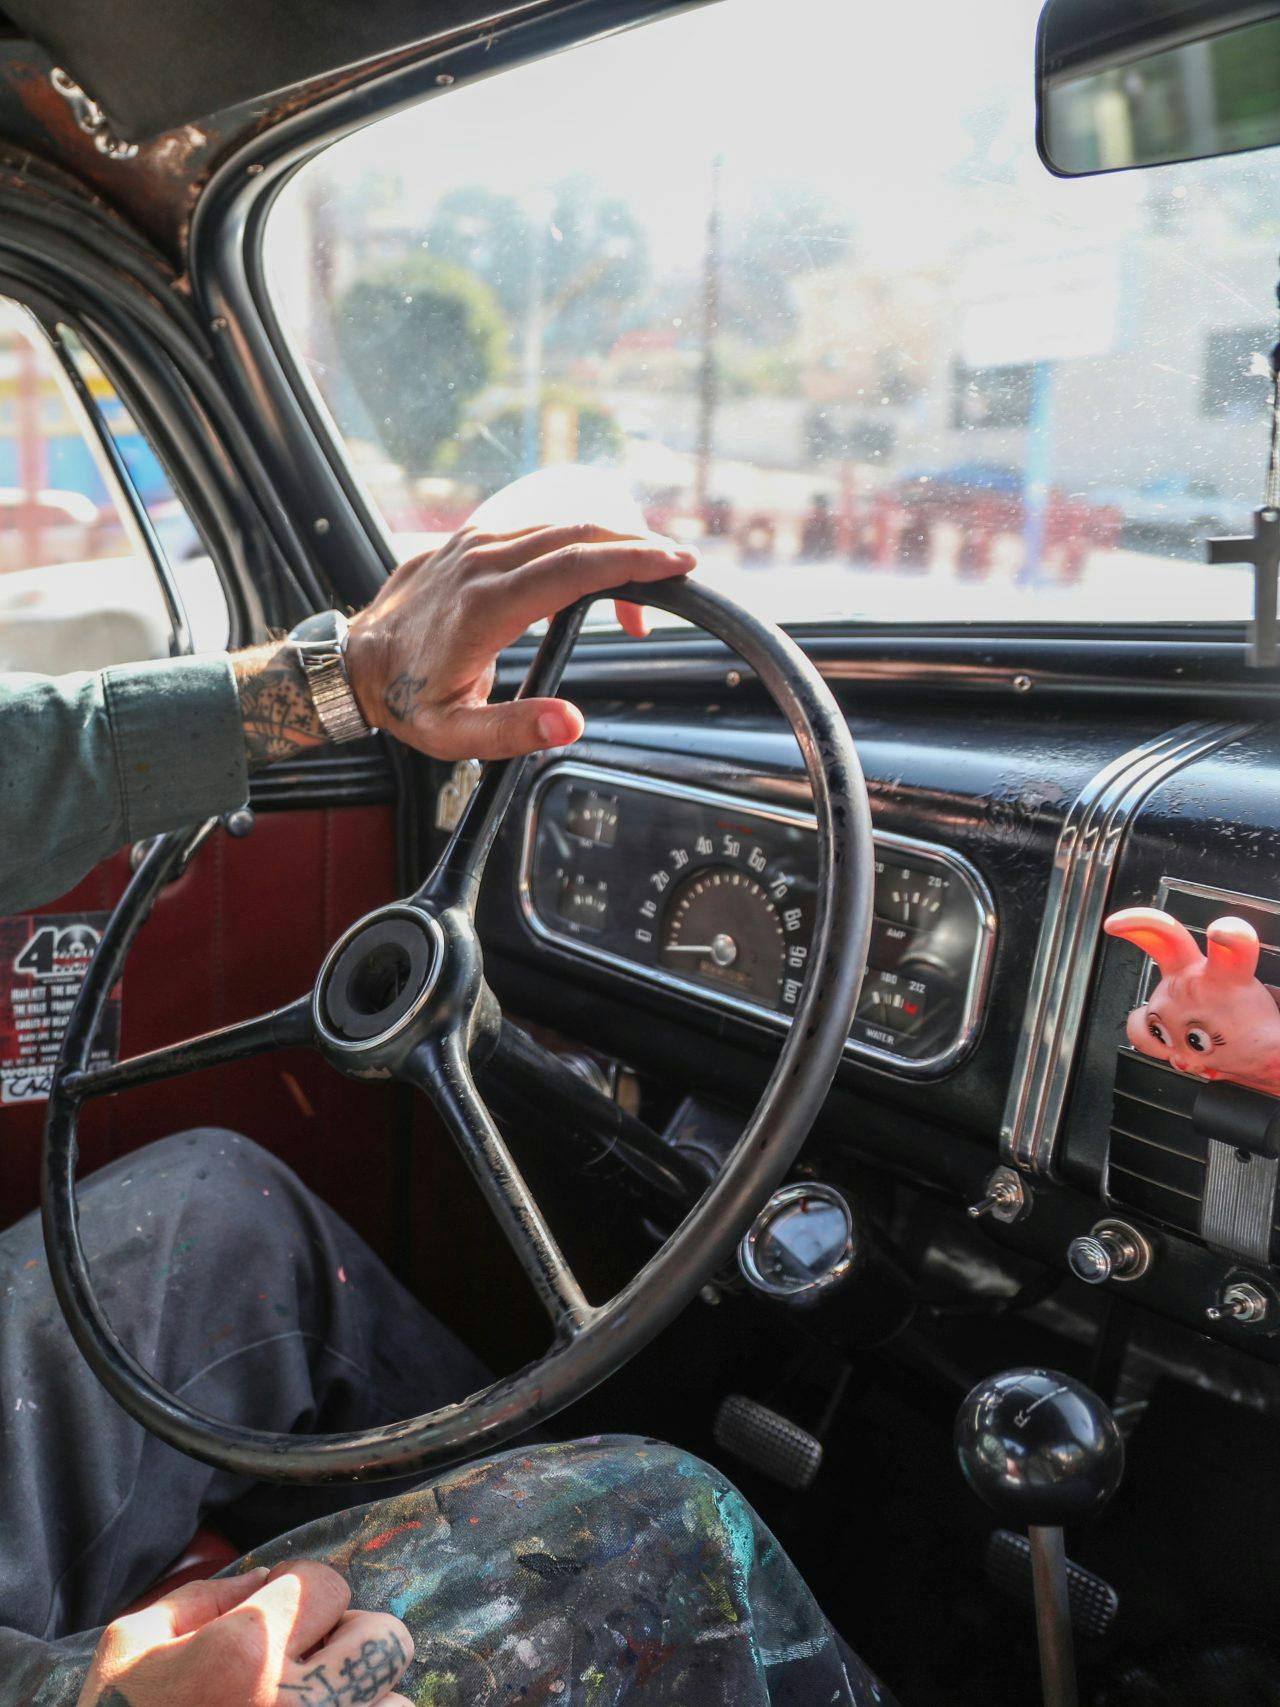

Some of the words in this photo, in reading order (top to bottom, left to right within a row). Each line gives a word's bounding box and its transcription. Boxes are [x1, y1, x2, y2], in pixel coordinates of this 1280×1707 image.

[695, 836, 713, 855] 40
[723, 834, 740, 857] 50
[670, 849, 689, 869] 30
[748, 846, 767, 872] 60
[650, 870, 670, 892] 20
[770, 871, 788, 898] 70
[639, 900, 657, 919] 10
[784, 907, 802, 931] 80
[635, 929, 652, 942] 0
[887, 928, 906, 939] AMP
[789, 946, 808, 968] 90
[784, 979, 803, 1004] 100
[908, 980, 926, 994] 212
[866, 1028, 895, 1045] WATER
[1013, 1409, 1031, 1428] R
